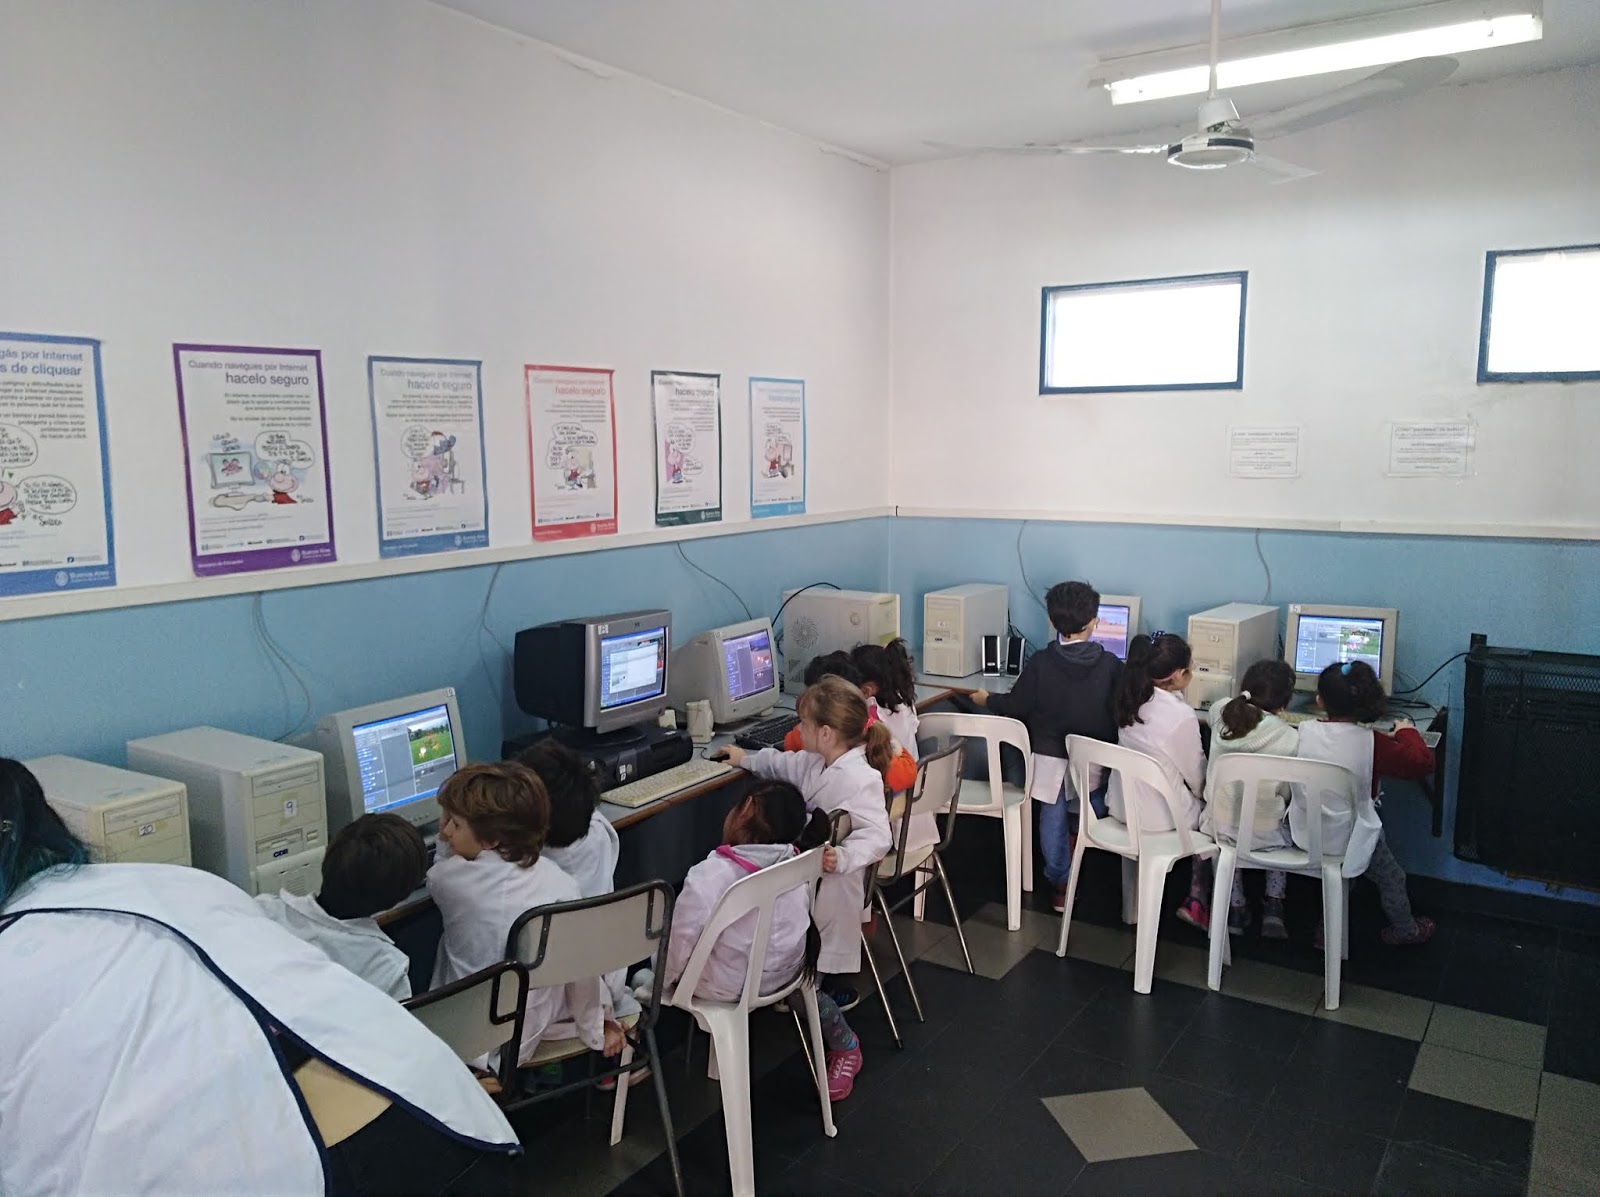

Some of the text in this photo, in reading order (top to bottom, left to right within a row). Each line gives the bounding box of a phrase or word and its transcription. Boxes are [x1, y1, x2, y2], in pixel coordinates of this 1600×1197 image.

[22, 350, 39, 361] por
[42, 350, 83, 361] Internet
[11, 362, 28, 373] de
[32, 362, 82, 377] cliquear
[188, 359, 308, 373] Cuando navegues por Internet
[225, 371, 309, 388] hacelo seguro
[407, 378, 473, 392] hacelo seguro
[286, 800, 294, 815] 9
